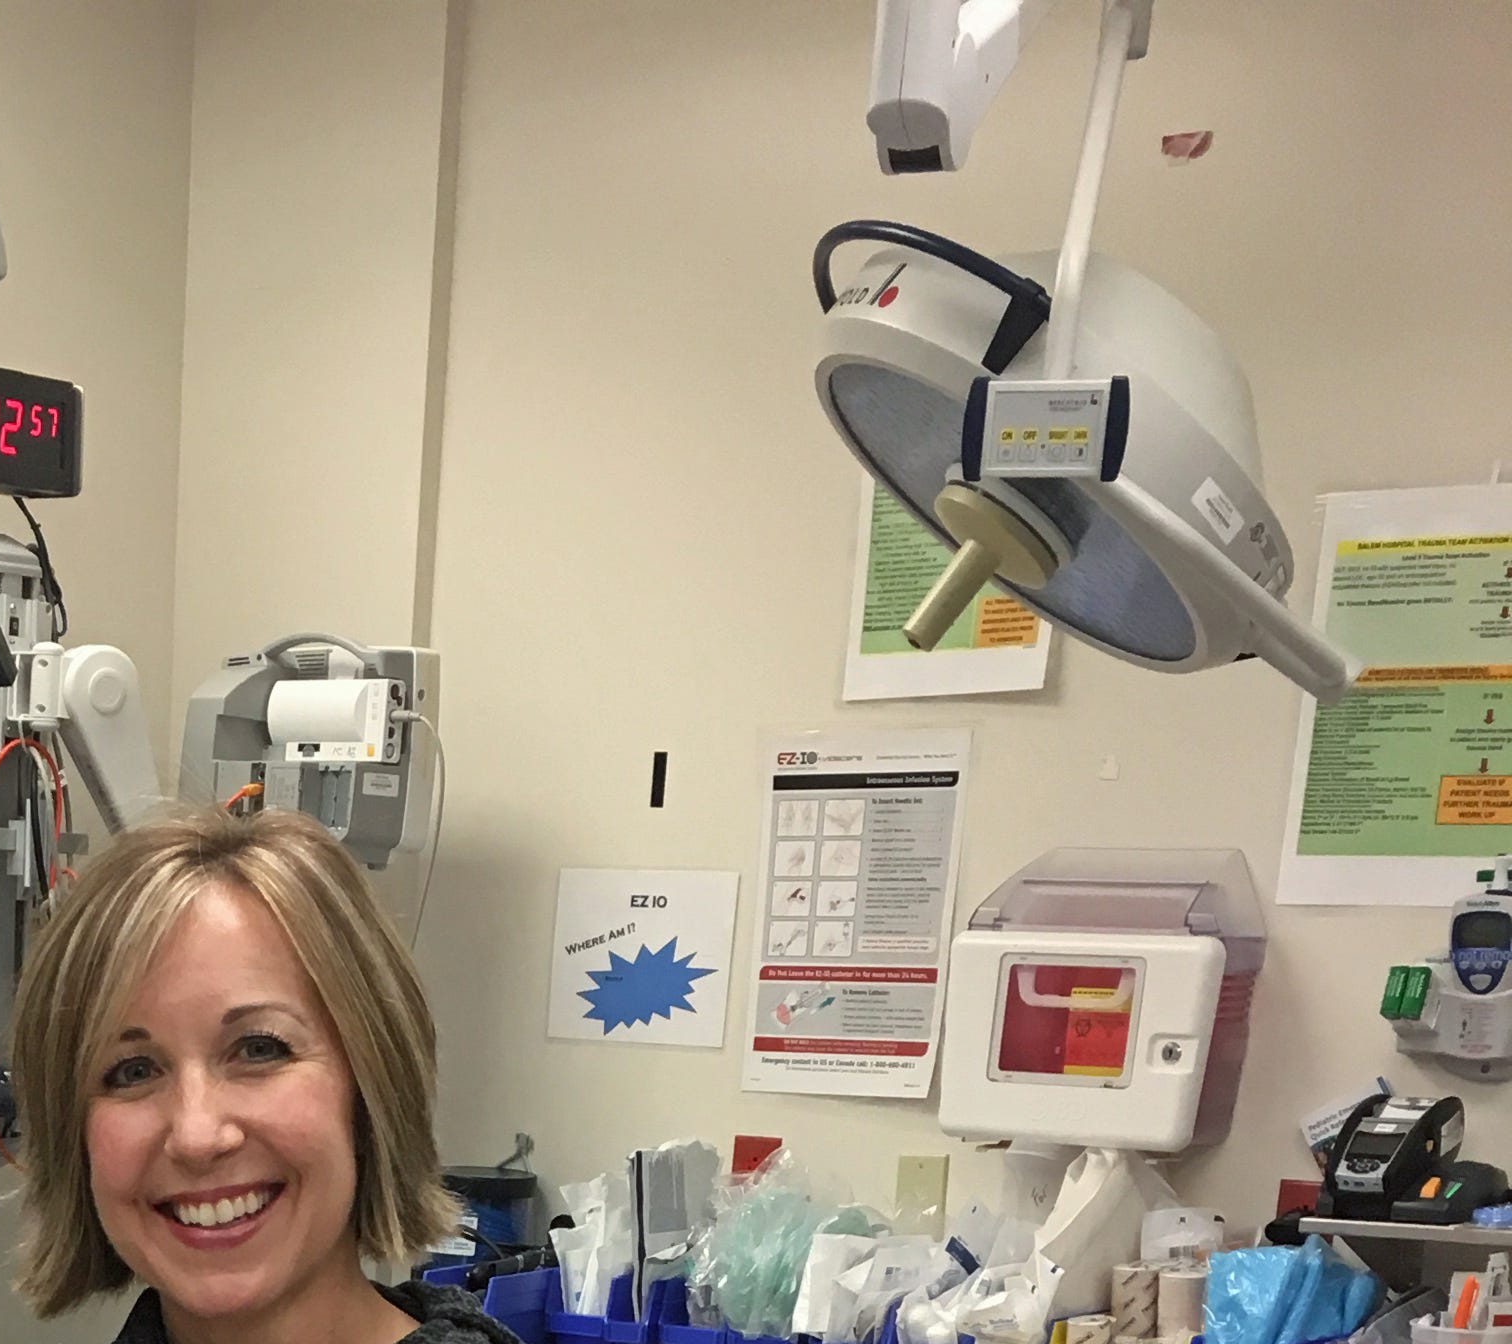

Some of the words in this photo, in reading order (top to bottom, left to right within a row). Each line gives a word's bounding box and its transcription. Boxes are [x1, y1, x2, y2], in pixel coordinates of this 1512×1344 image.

[29, 404, 59, 438] 57
[1001, 431, 1013, 440] ON
[1450, 789, 1481, 797] PATIENT
[1483, 789, 1510, 797] NEEDS
[1443, 800, 1479, 808] FURTHER
[630, 895, 649, 908] EZ
[565, 934, 606, 955] WHERE
[608, 928, 625, 941] AM
[627, 922, 637, 935] I?
